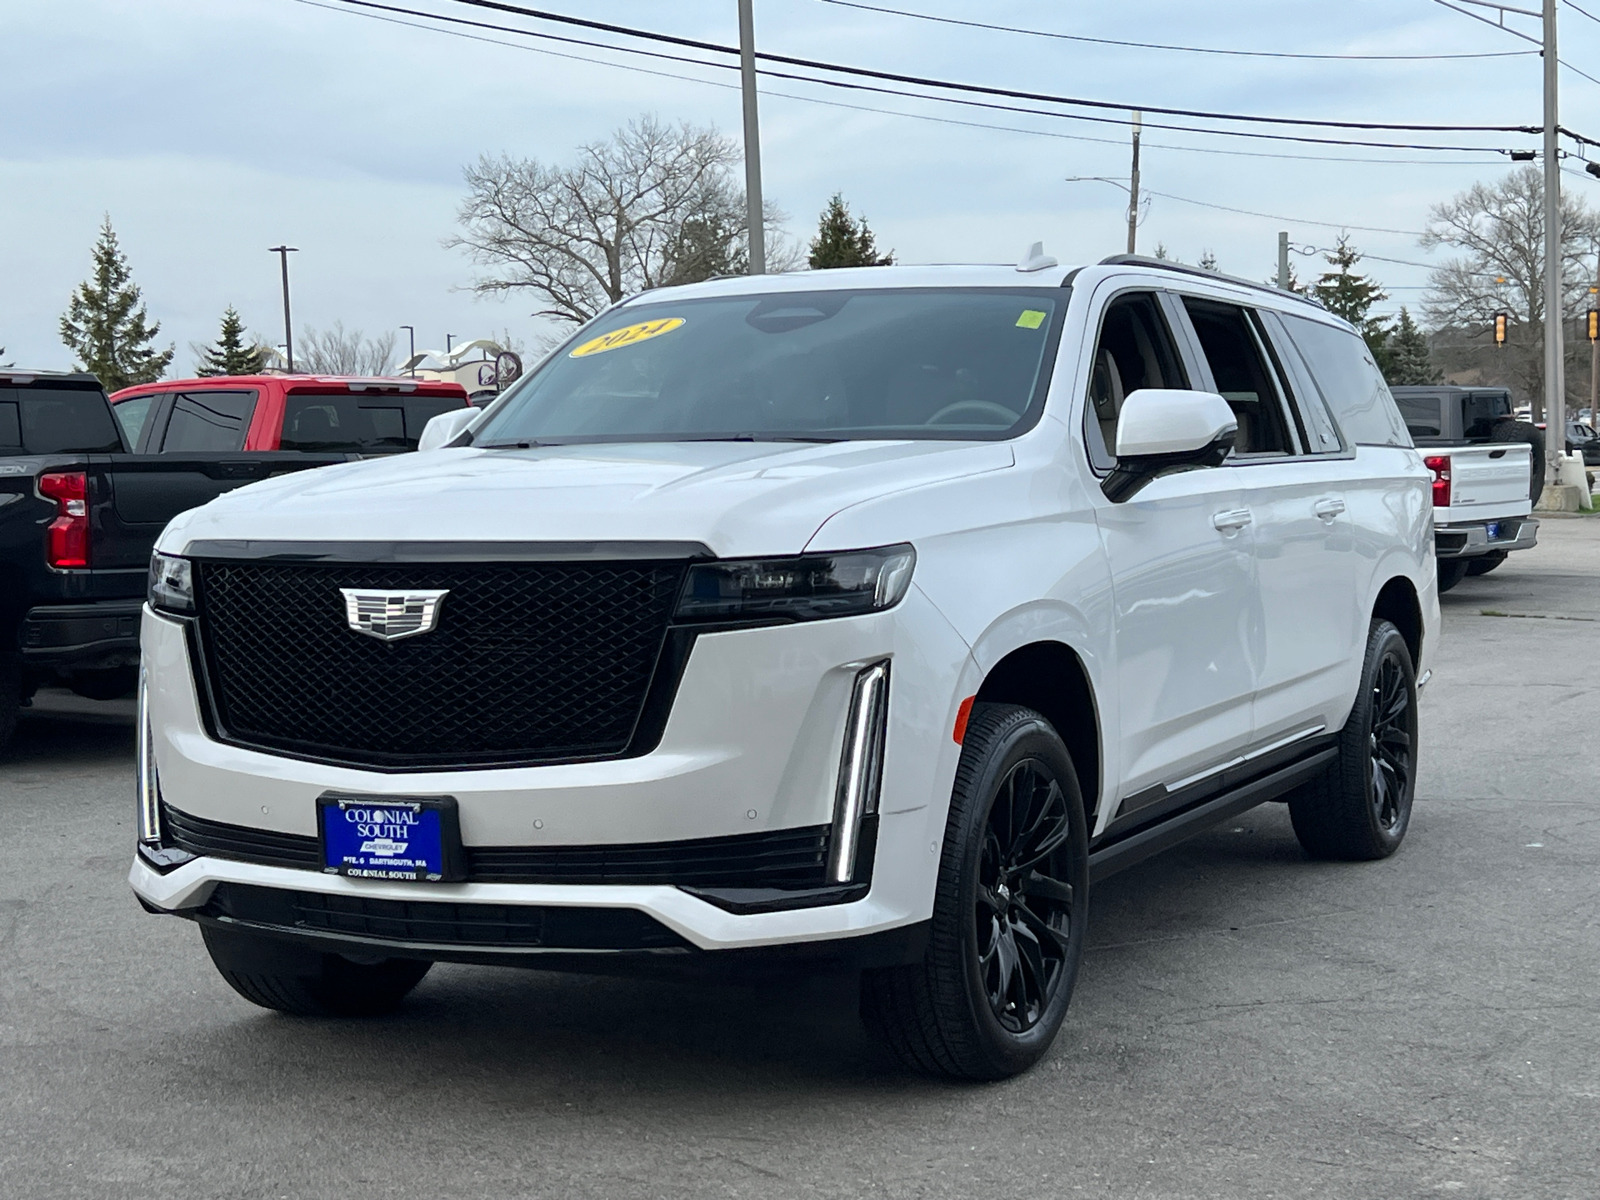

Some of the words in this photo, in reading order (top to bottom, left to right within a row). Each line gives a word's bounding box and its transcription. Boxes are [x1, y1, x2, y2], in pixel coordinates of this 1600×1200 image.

[582, 319, 673, 354] 2024
[345, 809, 419, 825] COLONIAL
[357, 824, 408, 838] SOUTH
[365, 843, 403, 851] CHEVROLET
[347, 868, 388, 878] COLONIAL
[388, 871, 417, 879] SOUTH
